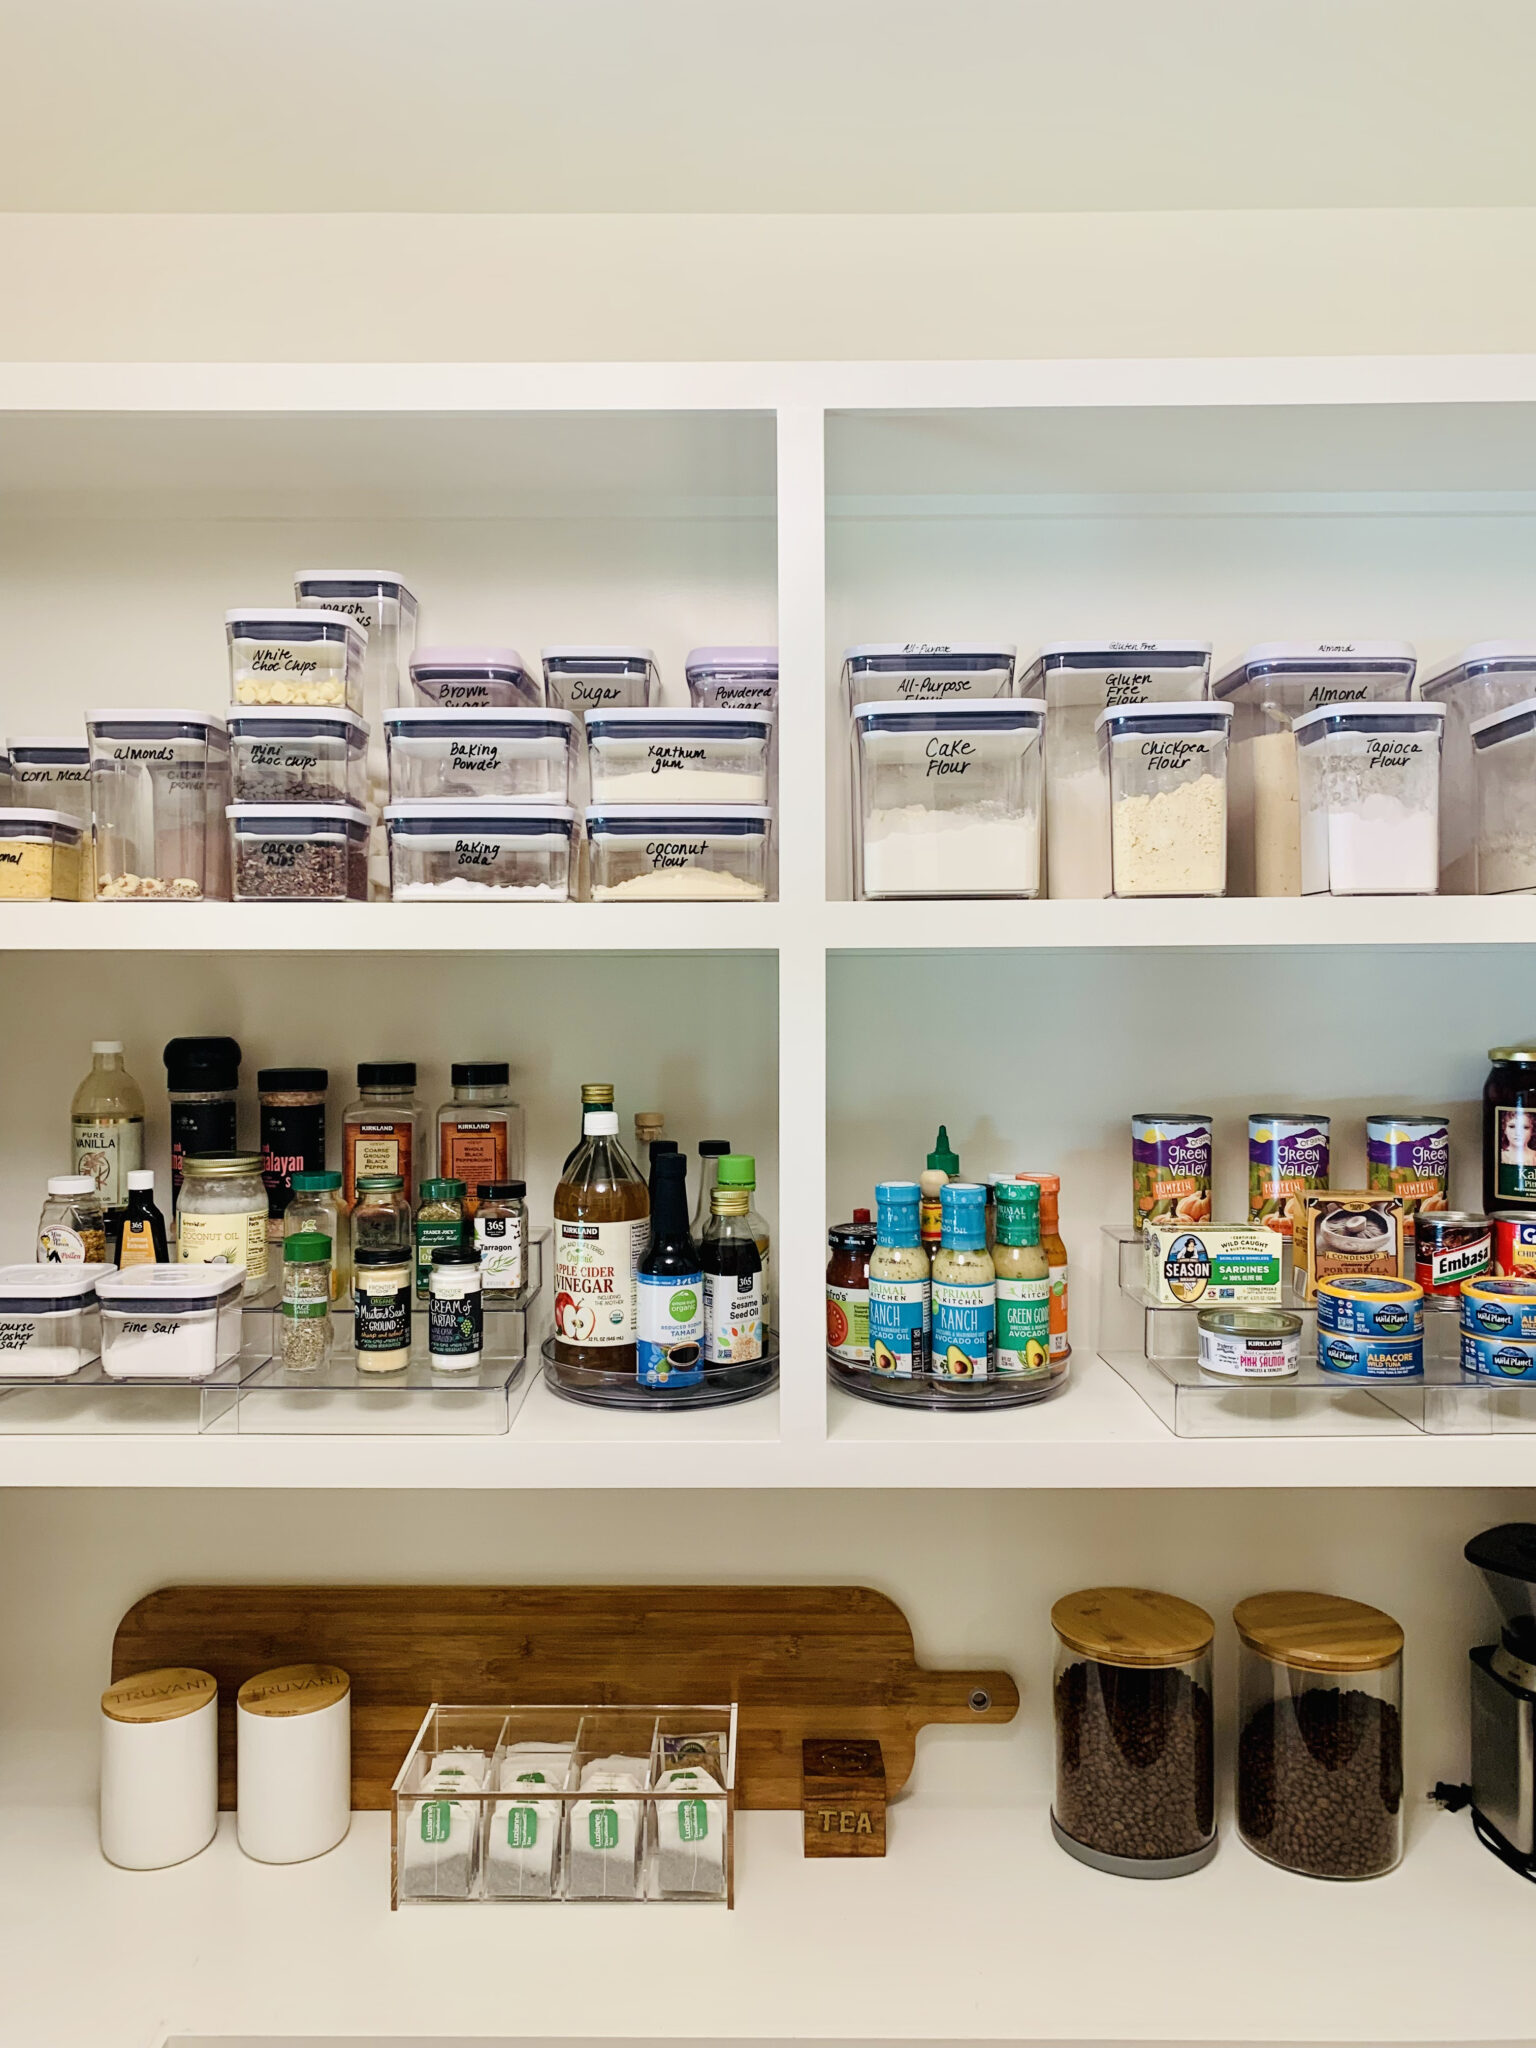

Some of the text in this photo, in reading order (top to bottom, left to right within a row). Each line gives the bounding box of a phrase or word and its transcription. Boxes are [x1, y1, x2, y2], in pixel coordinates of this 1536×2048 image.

[1318, 644, 1355, 652] Almond
[897, 677, 972, 696] All-Purpose
[1106, 674, 1152, 686] Gluten
[438, 684, 488, 699] Brown
[571, 682, 620, 707] Sugar
[715, 686, 772, 700] Powdered
[1107, 686, 1140, 697] Free
[1309, 686, 1368, 702] Almond
[1107, 696, 1148, 707] Flour
[250, 744, 283, 755] mini
[450, 742, 498, 759] Baking
[925, 737, 976, 758] Cake
[1141, 741, 1210, 758] Chickpea
[1366, 738, 1422, 755] Tapioca
[452, 756, 502, 770] Powder
[652, 758, 684, 773] gum
[926, 760, 972, 776] Flour
[1148, 756, 1191, 772] Flour
[1370, 756, 1410, 768] Flour
[22, 770, 52, 782] corn
[454, 840, 500, 856] Baking
[76, 1139, 116, 1148] VANILLA
[1155, 1181, 1191, 1194] PUMPKIN
[1265, 1181, 1300, 1194] PUMPKIN
[1398, 1182, 1434, 1195] PUMPKIN
[487, 1222, 504, 1230] 365
[564, 1226, 598, 1234] KIRKLAND
[183, 1232, 222, 1240] COCONUT
[480, 1244, 512, 1252] Tarragon
[1221, 1240, 1268, 1248] WILD CAUGHT
[566, 1252, 593, 1265] Orgnic
[1440, 1248, 1488, 1274] Embasa
[557, 1264, 614, 1277] APPLE CIDER
[1166, 1263, 1210, 1277] SEASON
[1220, 1266, 1270, 1274] SARDINES
[556, 1275, 614, 1294] VINEGAR
[739, 1278, 752, 1287] 365
[943, 1288, 983, 1298] PRIMAL
[430, 1300, 472, 1315] CREAM of
[672, 1304, 696, 1312] organic
[731, 1300, 758, 1310] Sesame
[431, 1312, 458, 1327] TARTAR
[730, 1308, 758, 1320] Seed Oil
[870, 1302, 900, 1326] RANCH
[942, 1308, 978, 1331] RANCH
[1008, 1308, 1032, 1324] GREEN
[1390, 1315, 1408, 1324] Planet
[1478, 1312, 1512, 1324] Wild Planet
[0, 1322, 35, 1332] ourse
[122, 1322, 180, 1334] Fine Salt
[369, 1321, 396, 1331] GROUND
[936, 1334, 972, 1344] AVOCADO
[1240, 1355, 1258, 1366] PINK
[1260, 1356, 1286, 1368] SALMON
[1328, 1350, 1358, 1362] Wild Planet
[1368, 1353, 1412, 1362] ALBACORE
[1494, 1357, 1532, 1366] Wild Planet
[112, 1678, 208, 1704] TRUVANI
[818, 1810, 872, 1834] TEA
